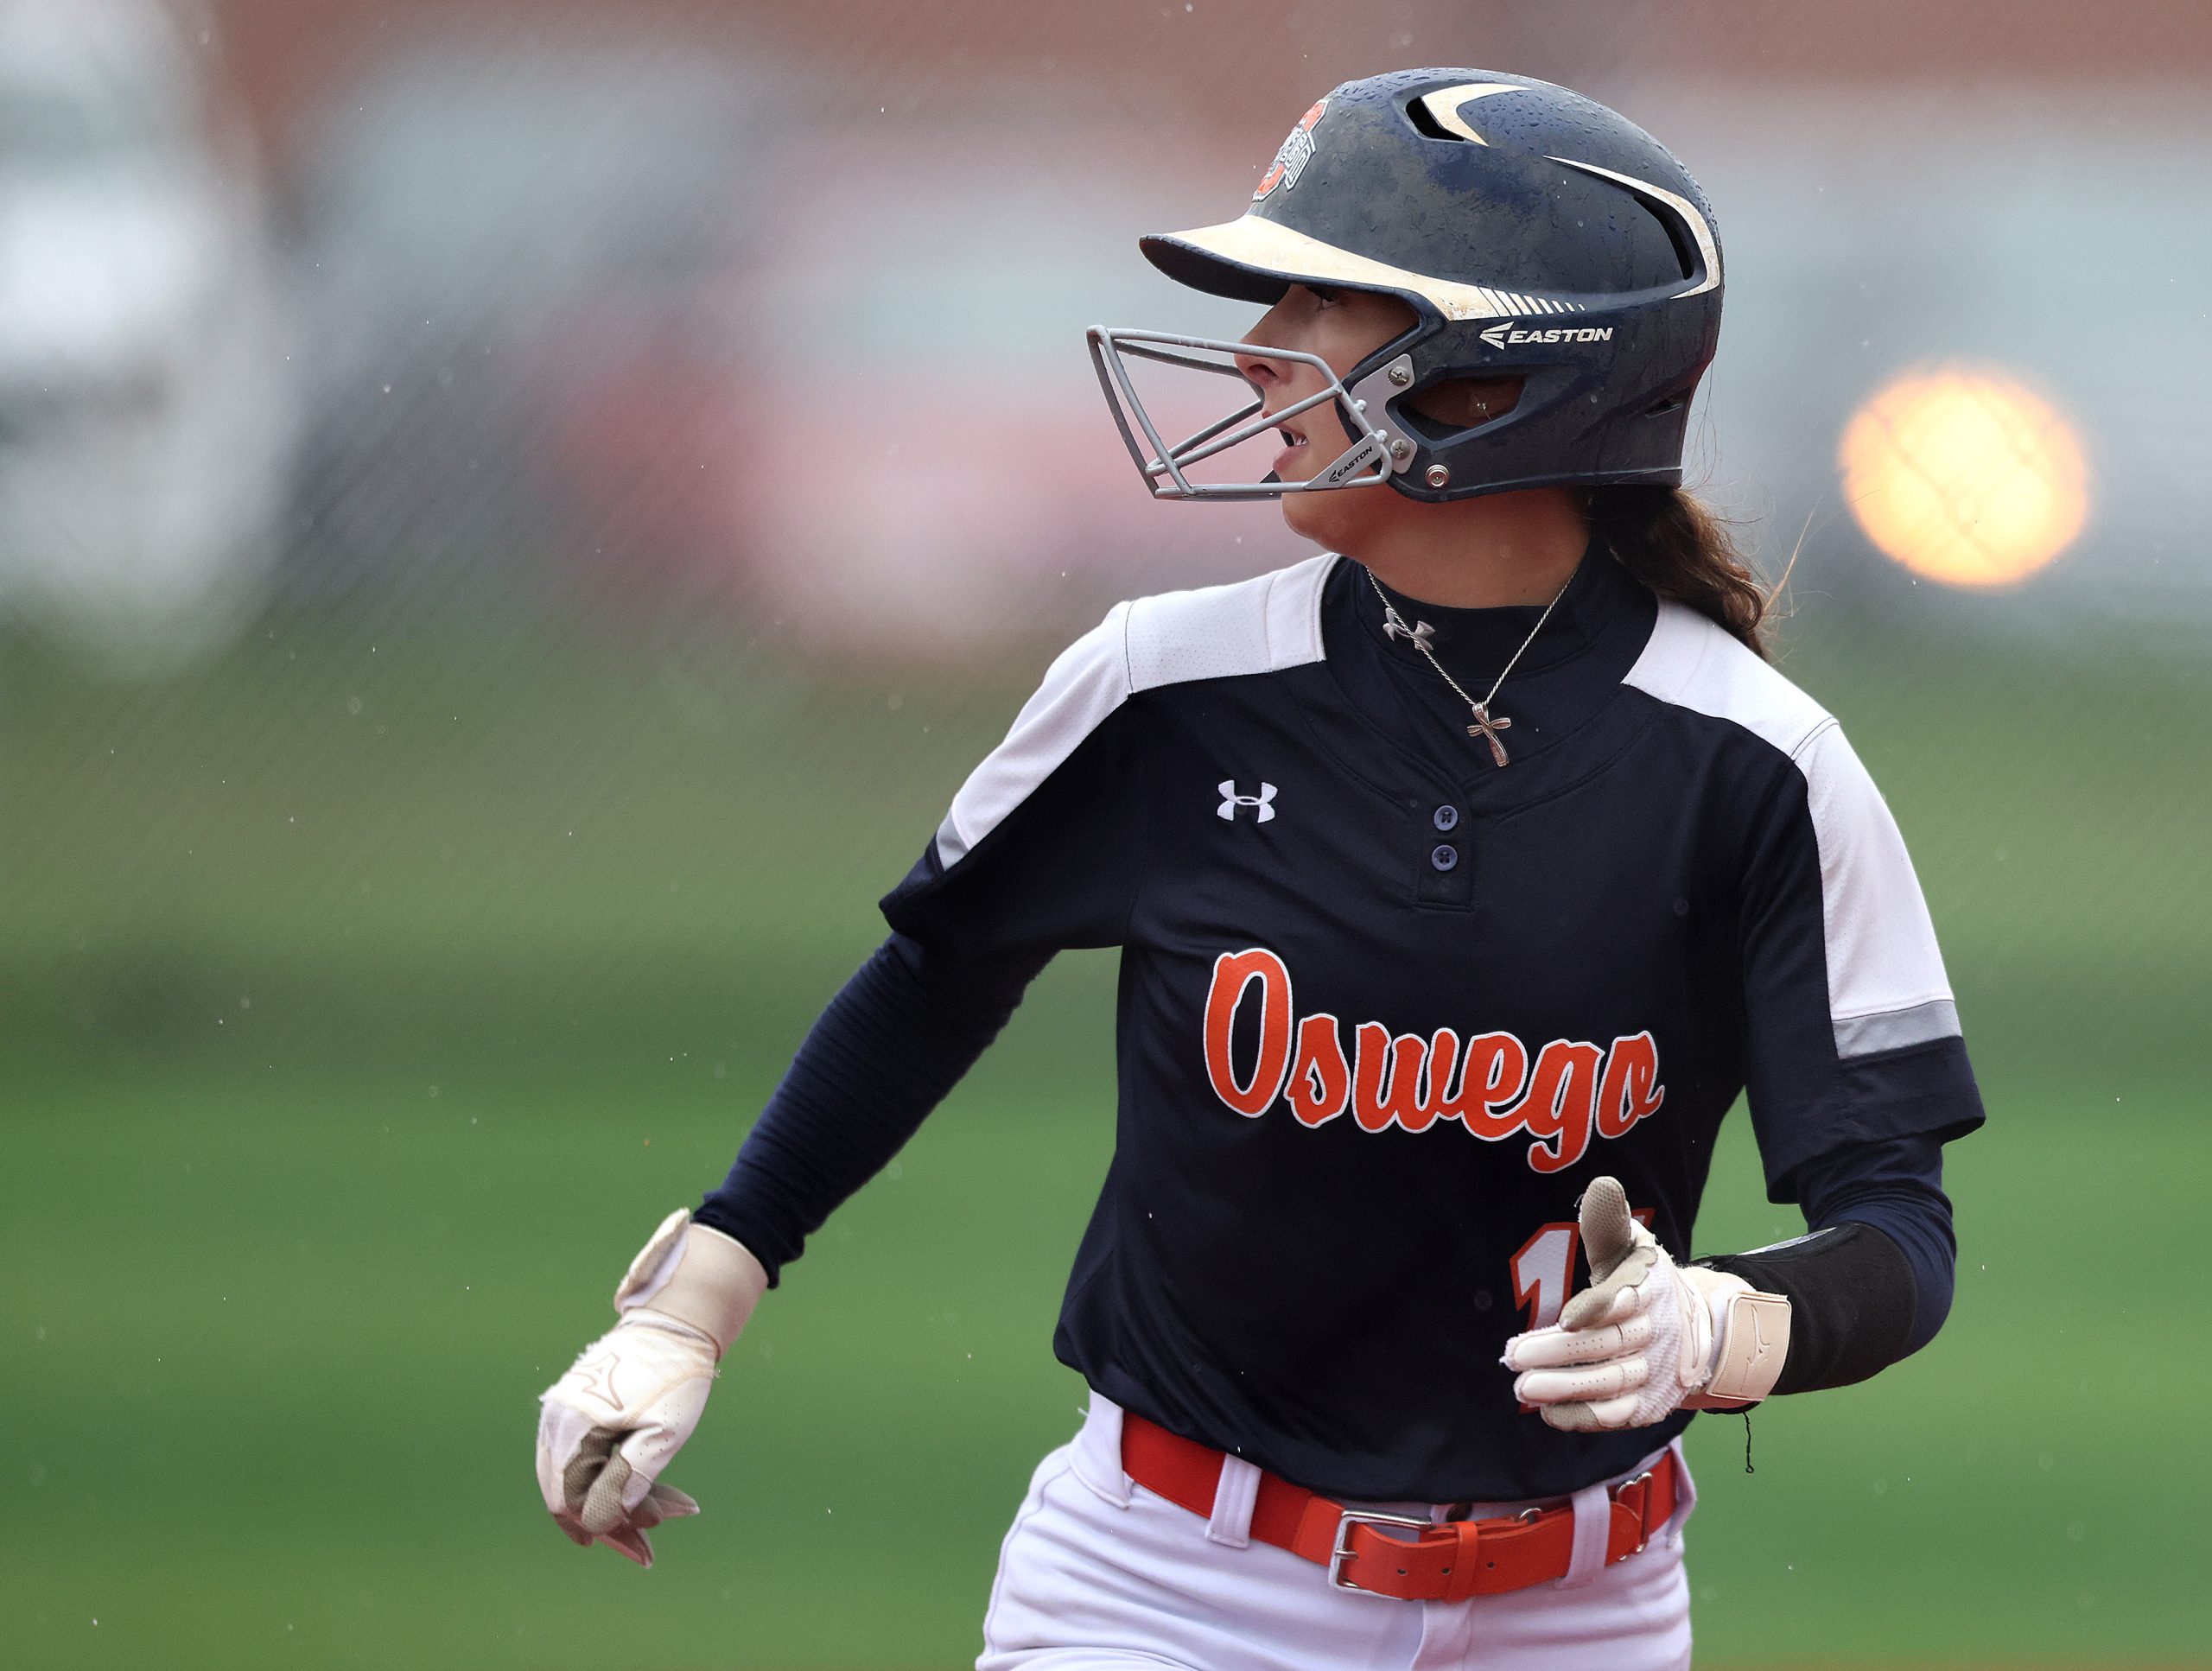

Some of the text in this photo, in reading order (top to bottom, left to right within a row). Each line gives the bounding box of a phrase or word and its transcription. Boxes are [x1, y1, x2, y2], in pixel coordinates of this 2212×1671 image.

[1507, 327, 1613, 344] EASTON
[1338, 446, 1373, 477] EASTON
[1204, 948, 1665, 1173] Oswego
